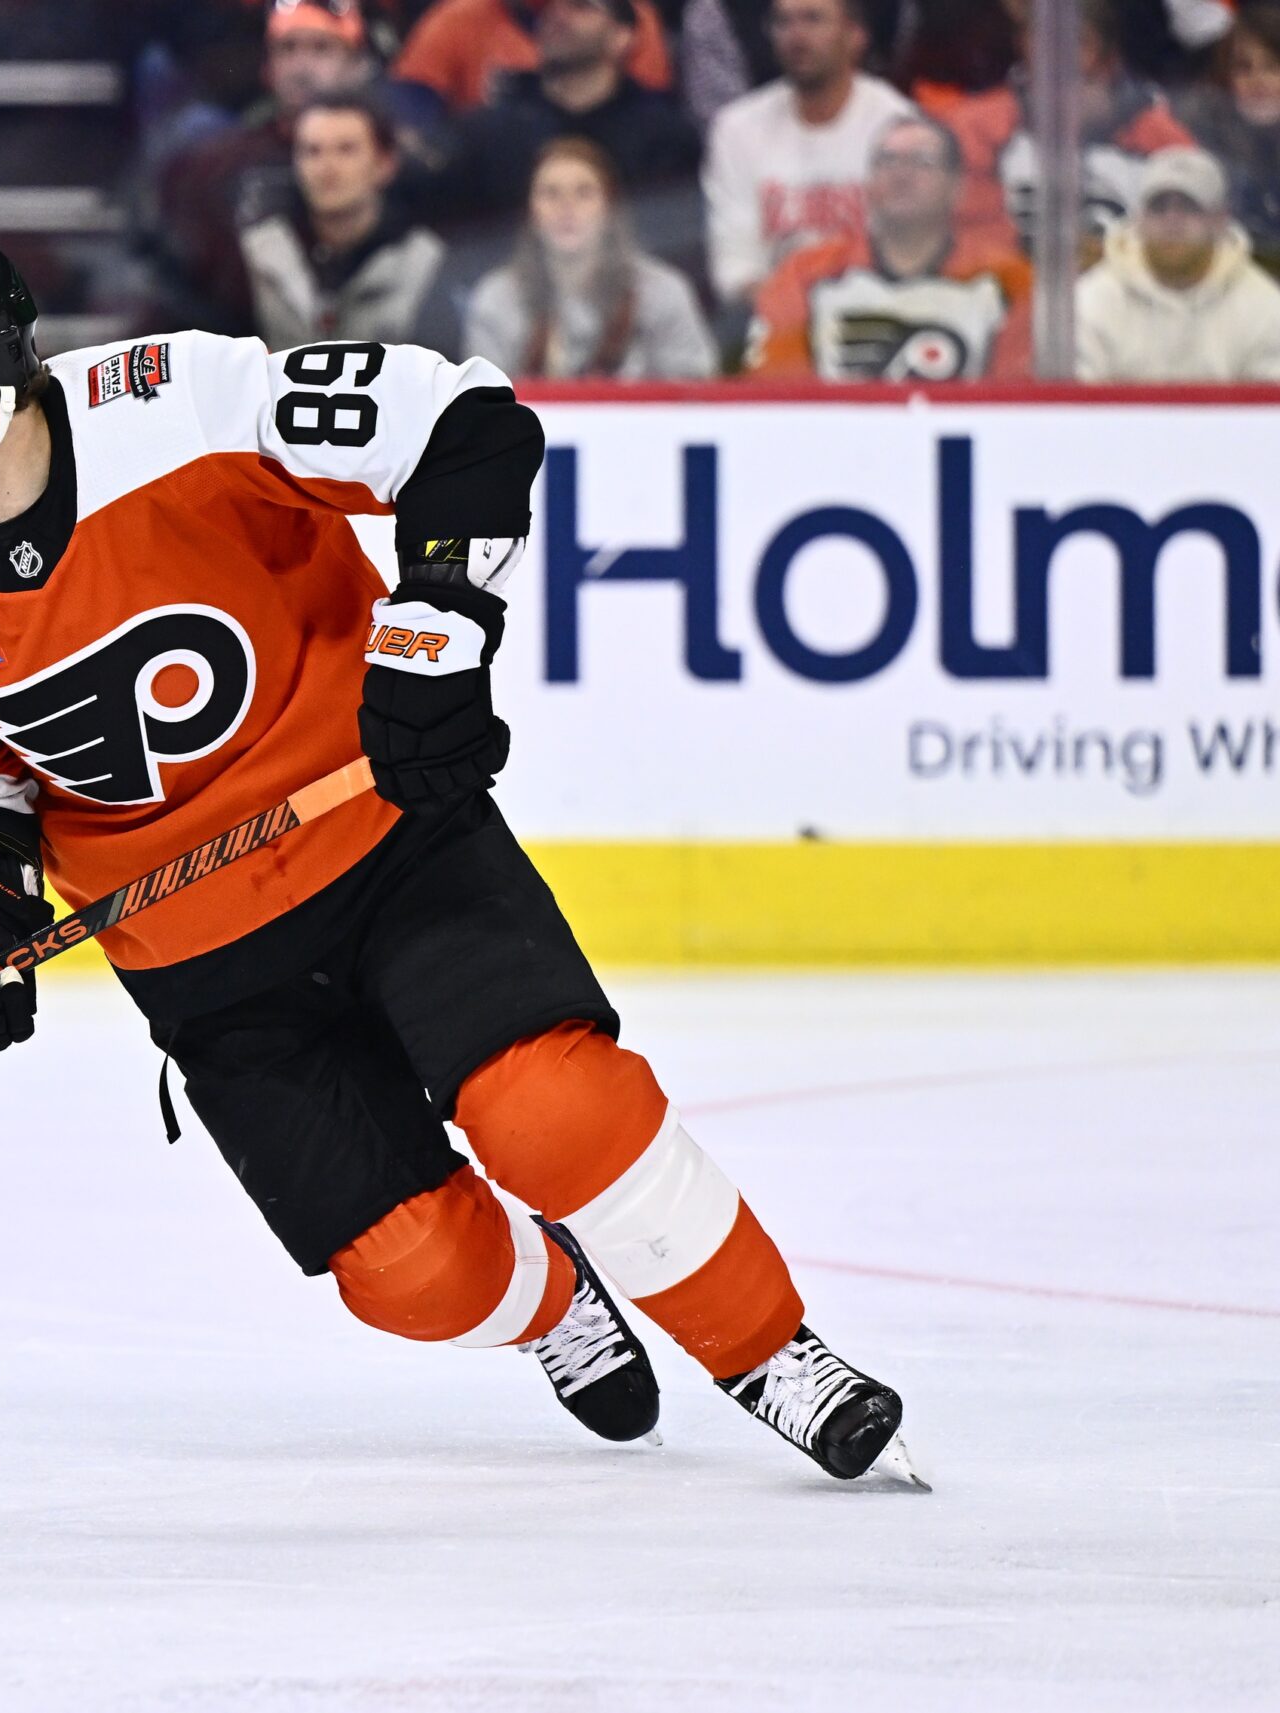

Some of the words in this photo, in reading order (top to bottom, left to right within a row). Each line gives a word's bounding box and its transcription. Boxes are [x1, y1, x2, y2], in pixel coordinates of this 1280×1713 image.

[111, 357, 122, 395] FAME
[275, 341, 387, 448] 89
[542, 434, 1280, 684] Holm
[907, 713, 1163, 797] Driving
